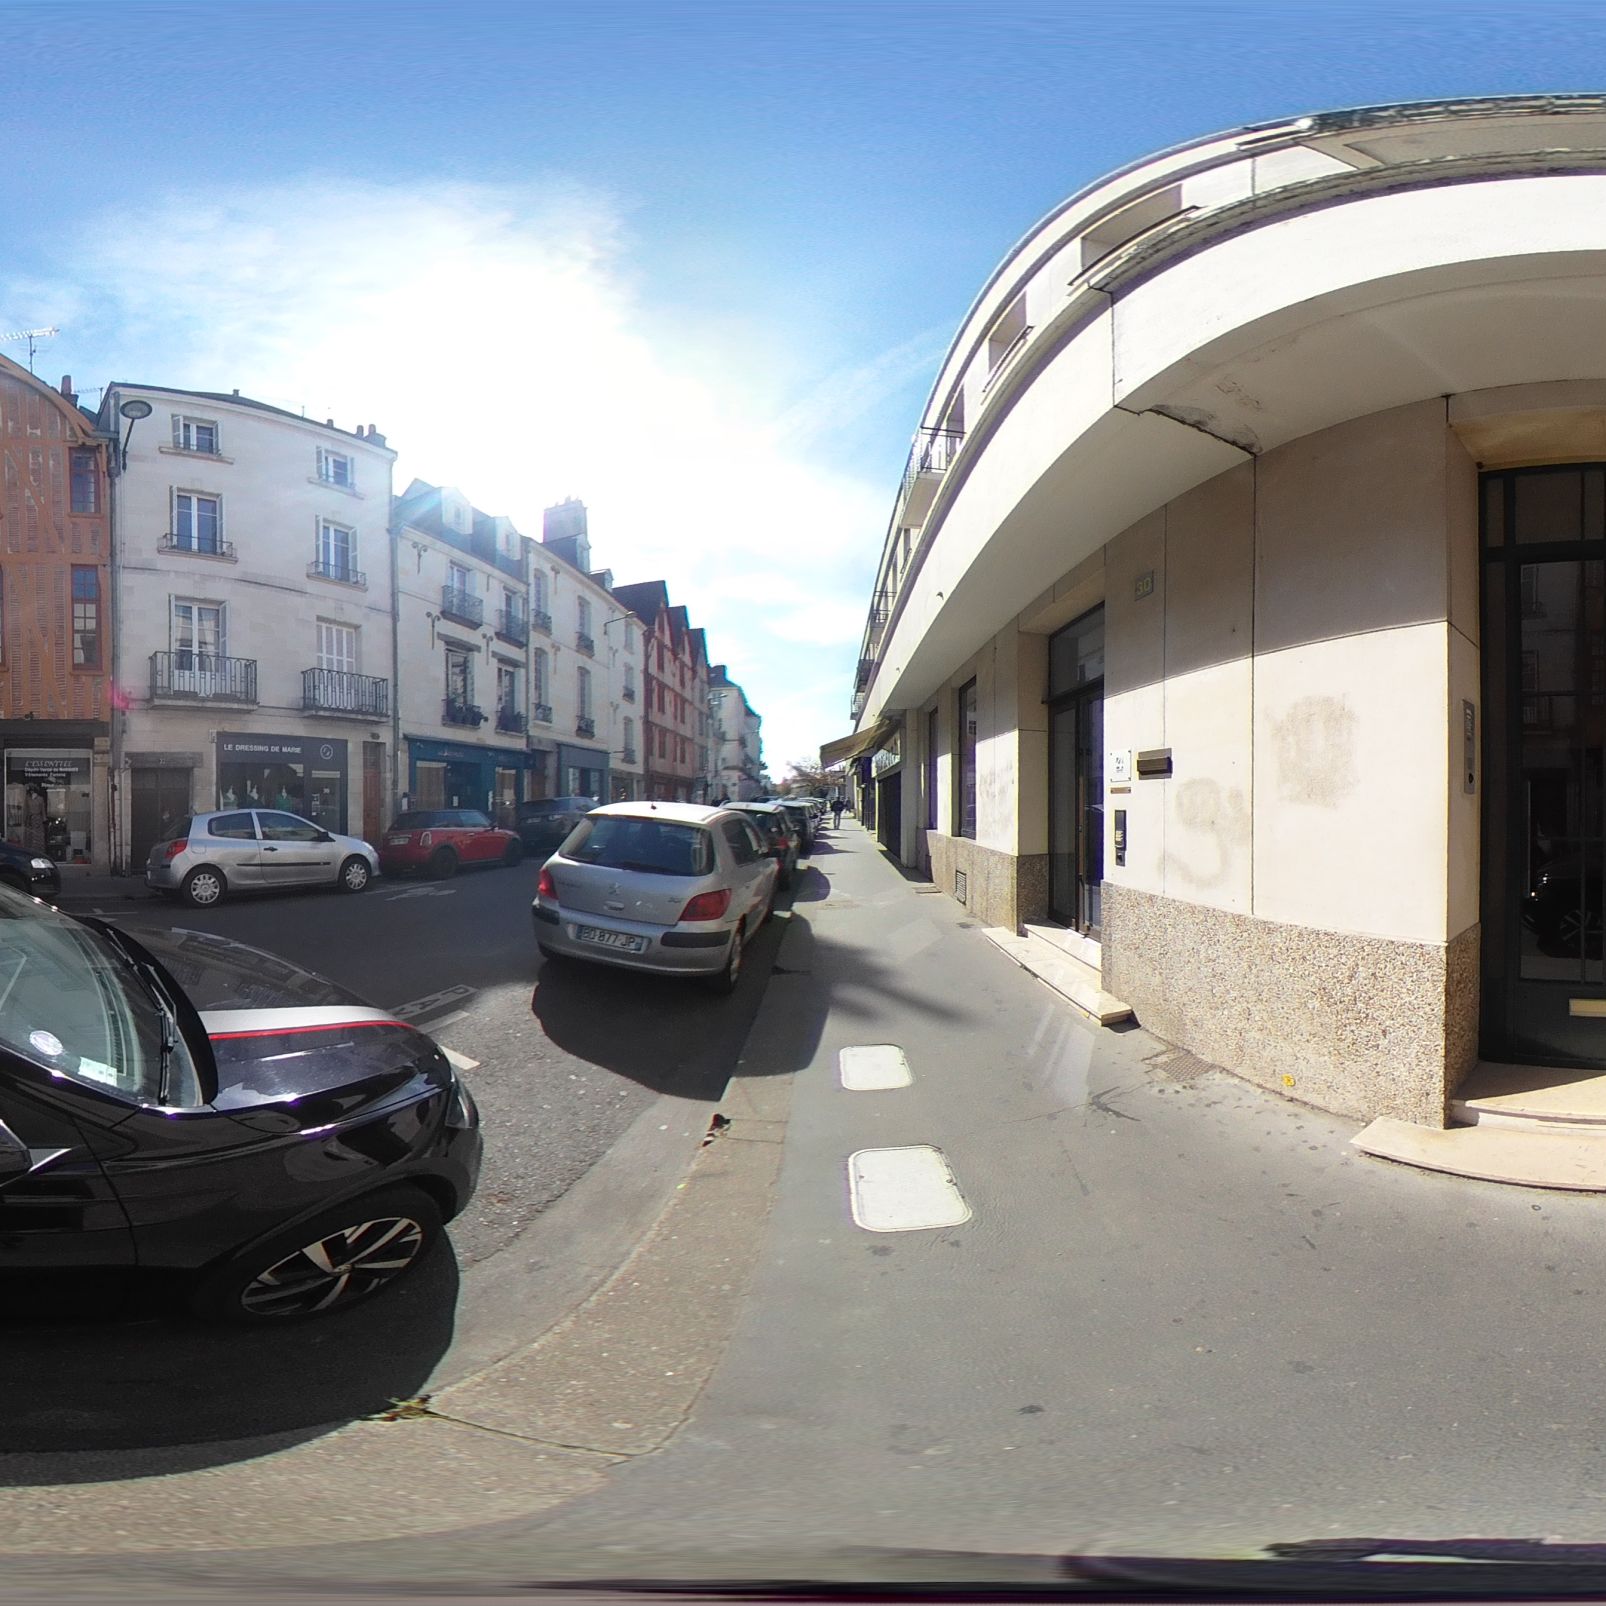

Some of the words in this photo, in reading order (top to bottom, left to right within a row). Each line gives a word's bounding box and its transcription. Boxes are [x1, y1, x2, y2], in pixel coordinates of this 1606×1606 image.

[1135, 576, 1152, 596] 30
[223, 743, 233, 751] LE
[235, 744, 269, 752] DRESSING
[270, 745, 280, 753] DE
